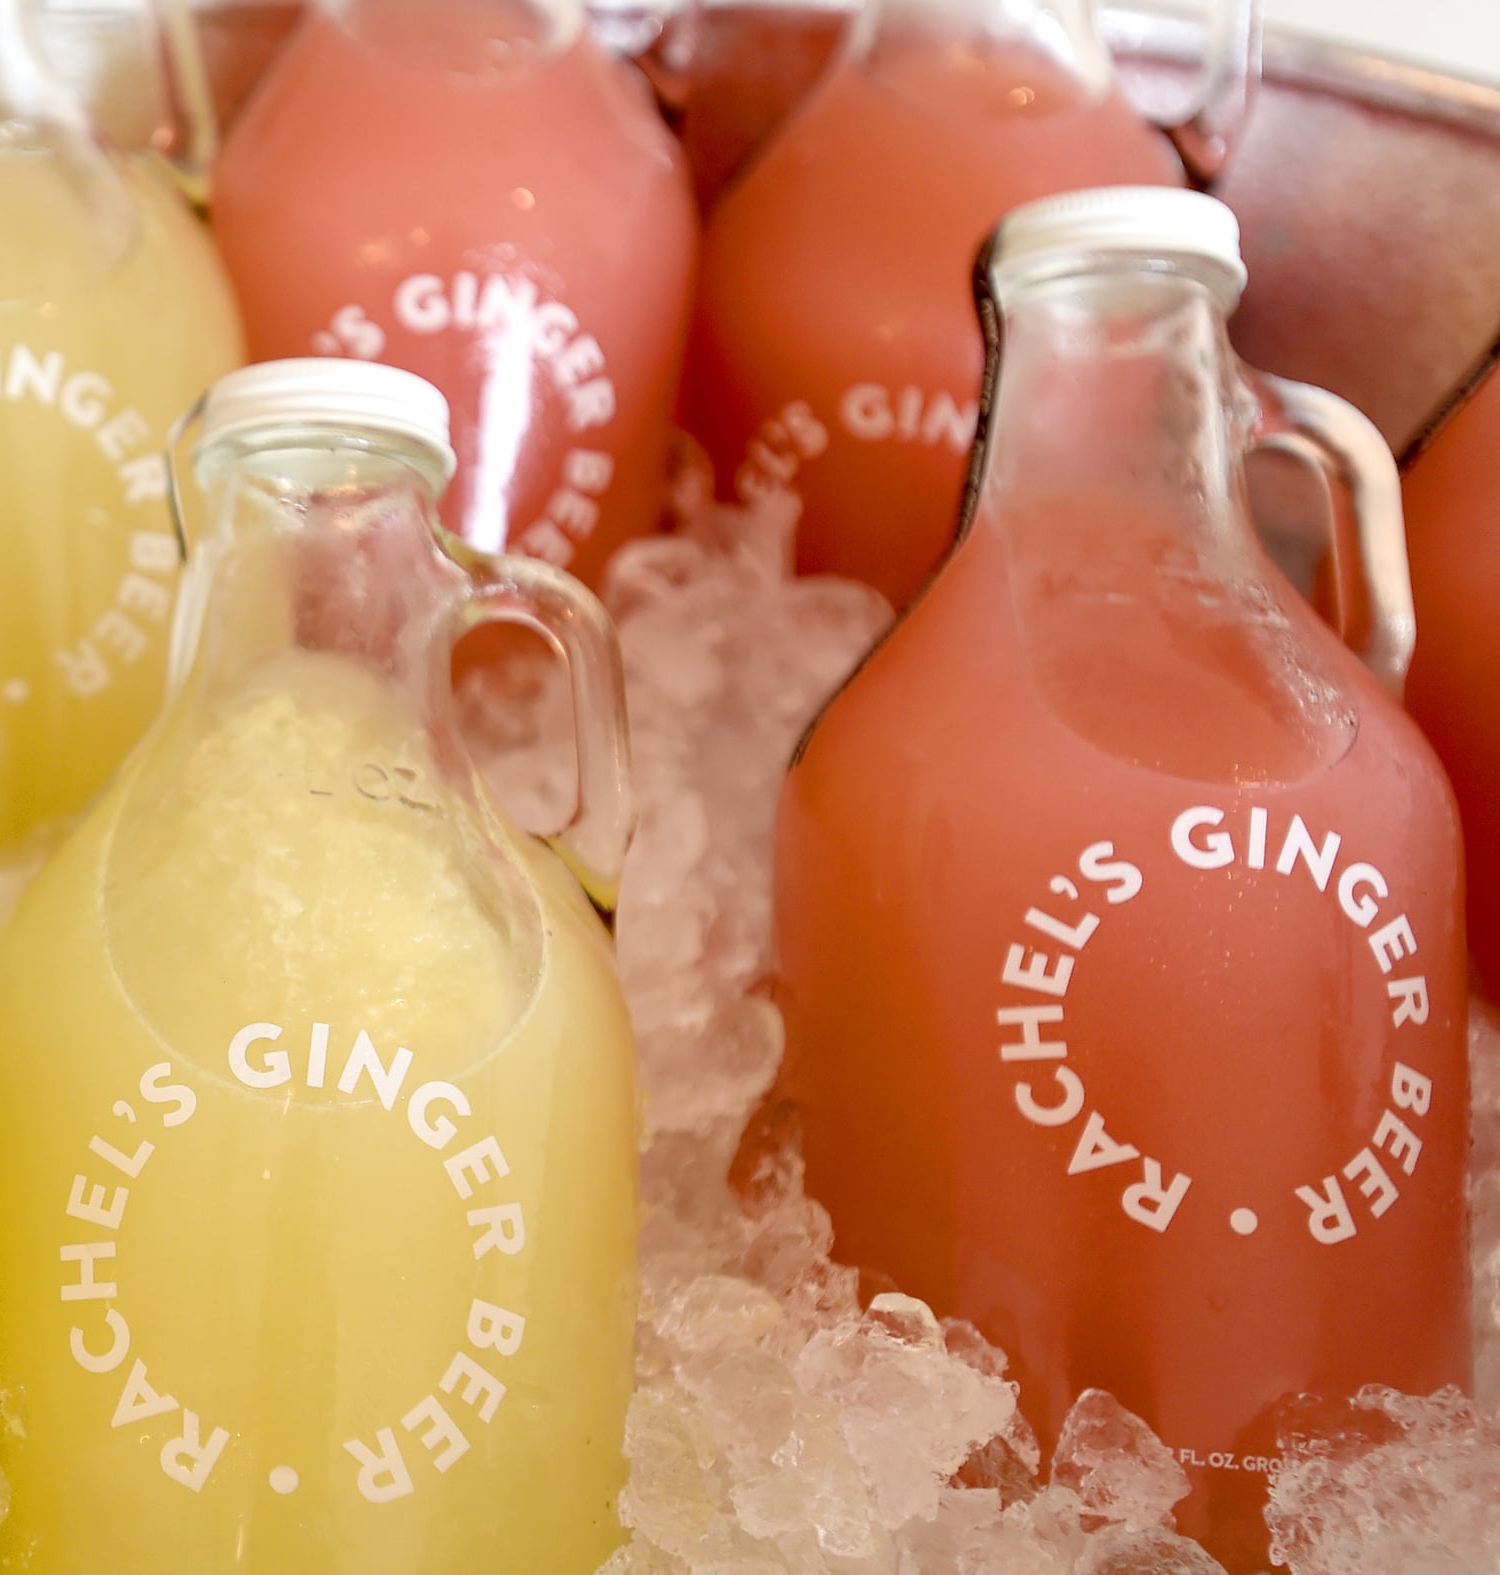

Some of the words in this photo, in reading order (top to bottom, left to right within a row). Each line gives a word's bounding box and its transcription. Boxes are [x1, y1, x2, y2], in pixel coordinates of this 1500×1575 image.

[393, 270, 616, 433] GINGER
[55, 530, 180, 697] BEER
[1171, 806, 1430, 1028] GINGER
[997, 840, 1192, 1232] RACHEL'S
[228, 1022, 526, 1260] GINGER
[1296, 1063, 1432, 1246] BEER
[60, 1061, 231, 1492] RACHEL'S
[344, 1298, 526, 1504] BEER
[1180, 1448, 1205, 1466] FL.
[1209, 1452, 1239, 1470] OZ.
[1242, 1455, 1282, 1474] GRO
